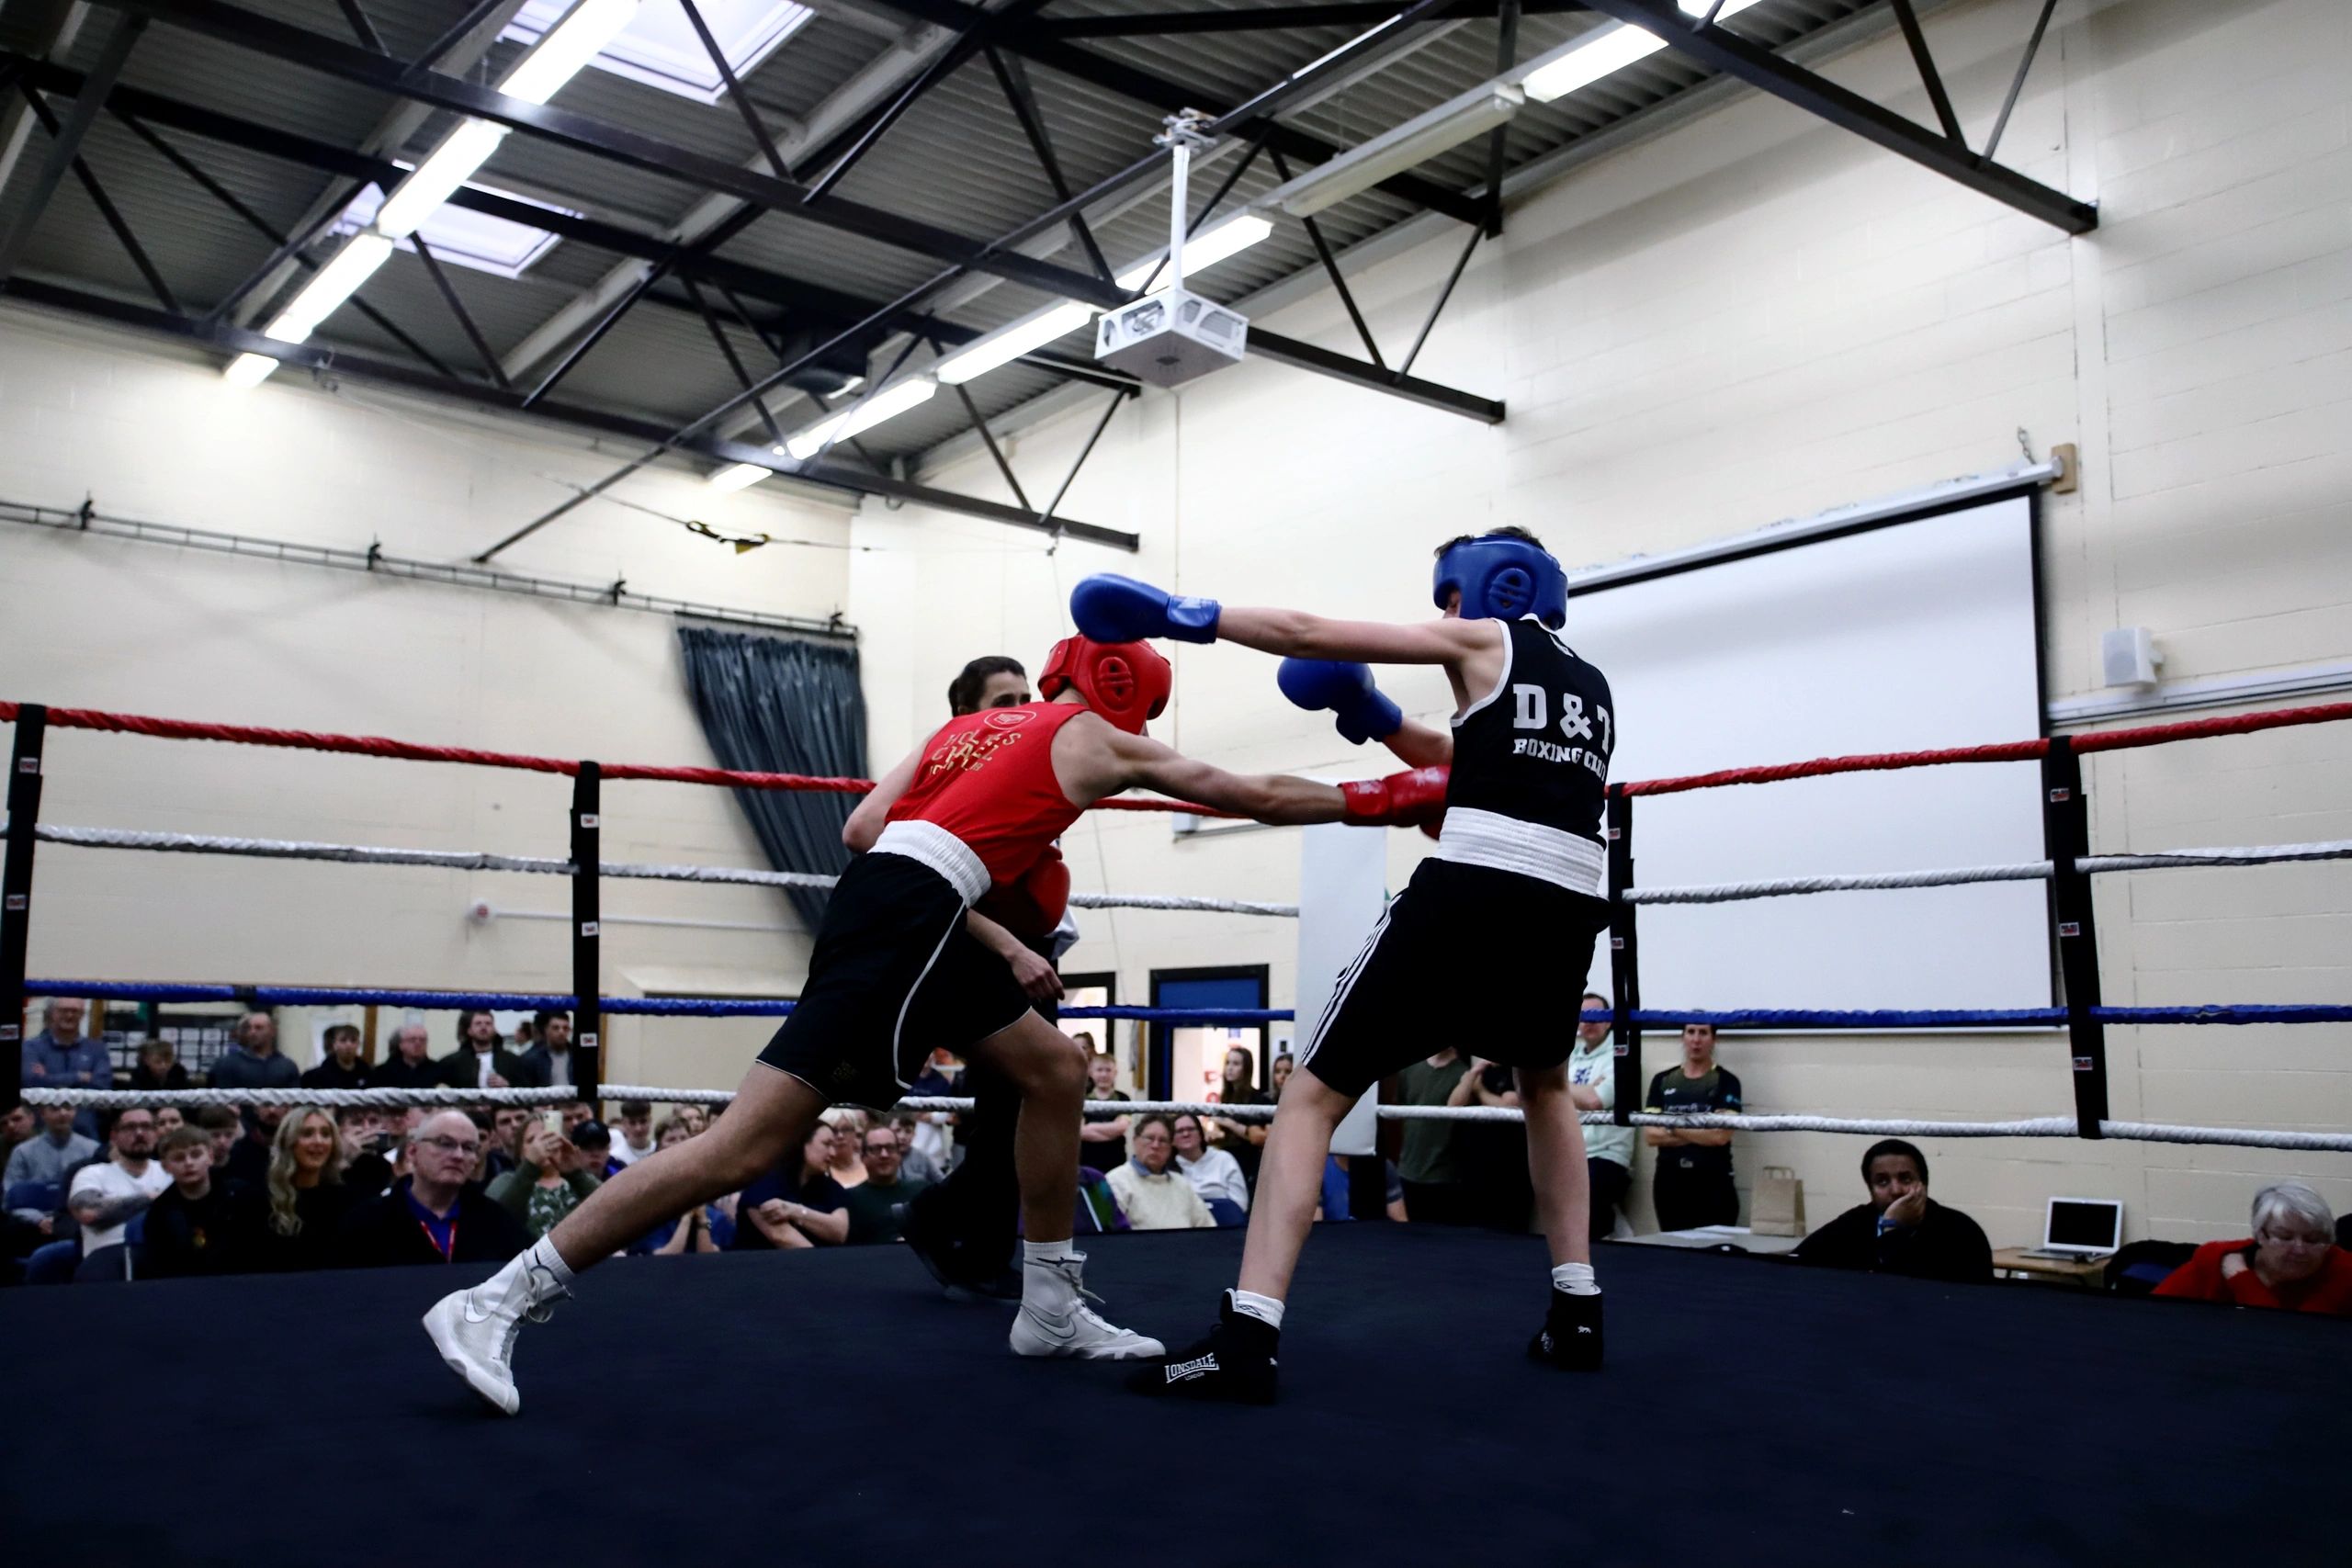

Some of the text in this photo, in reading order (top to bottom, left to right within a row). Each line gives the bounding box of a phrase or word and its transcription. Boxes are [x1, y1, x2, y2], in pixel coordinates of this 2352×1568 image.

[1512, 683, 1611, 753] D & T
[1512, 738, 1583, 763] BOXING
[1164, 1352, 1219, 1383] LONSDALE
